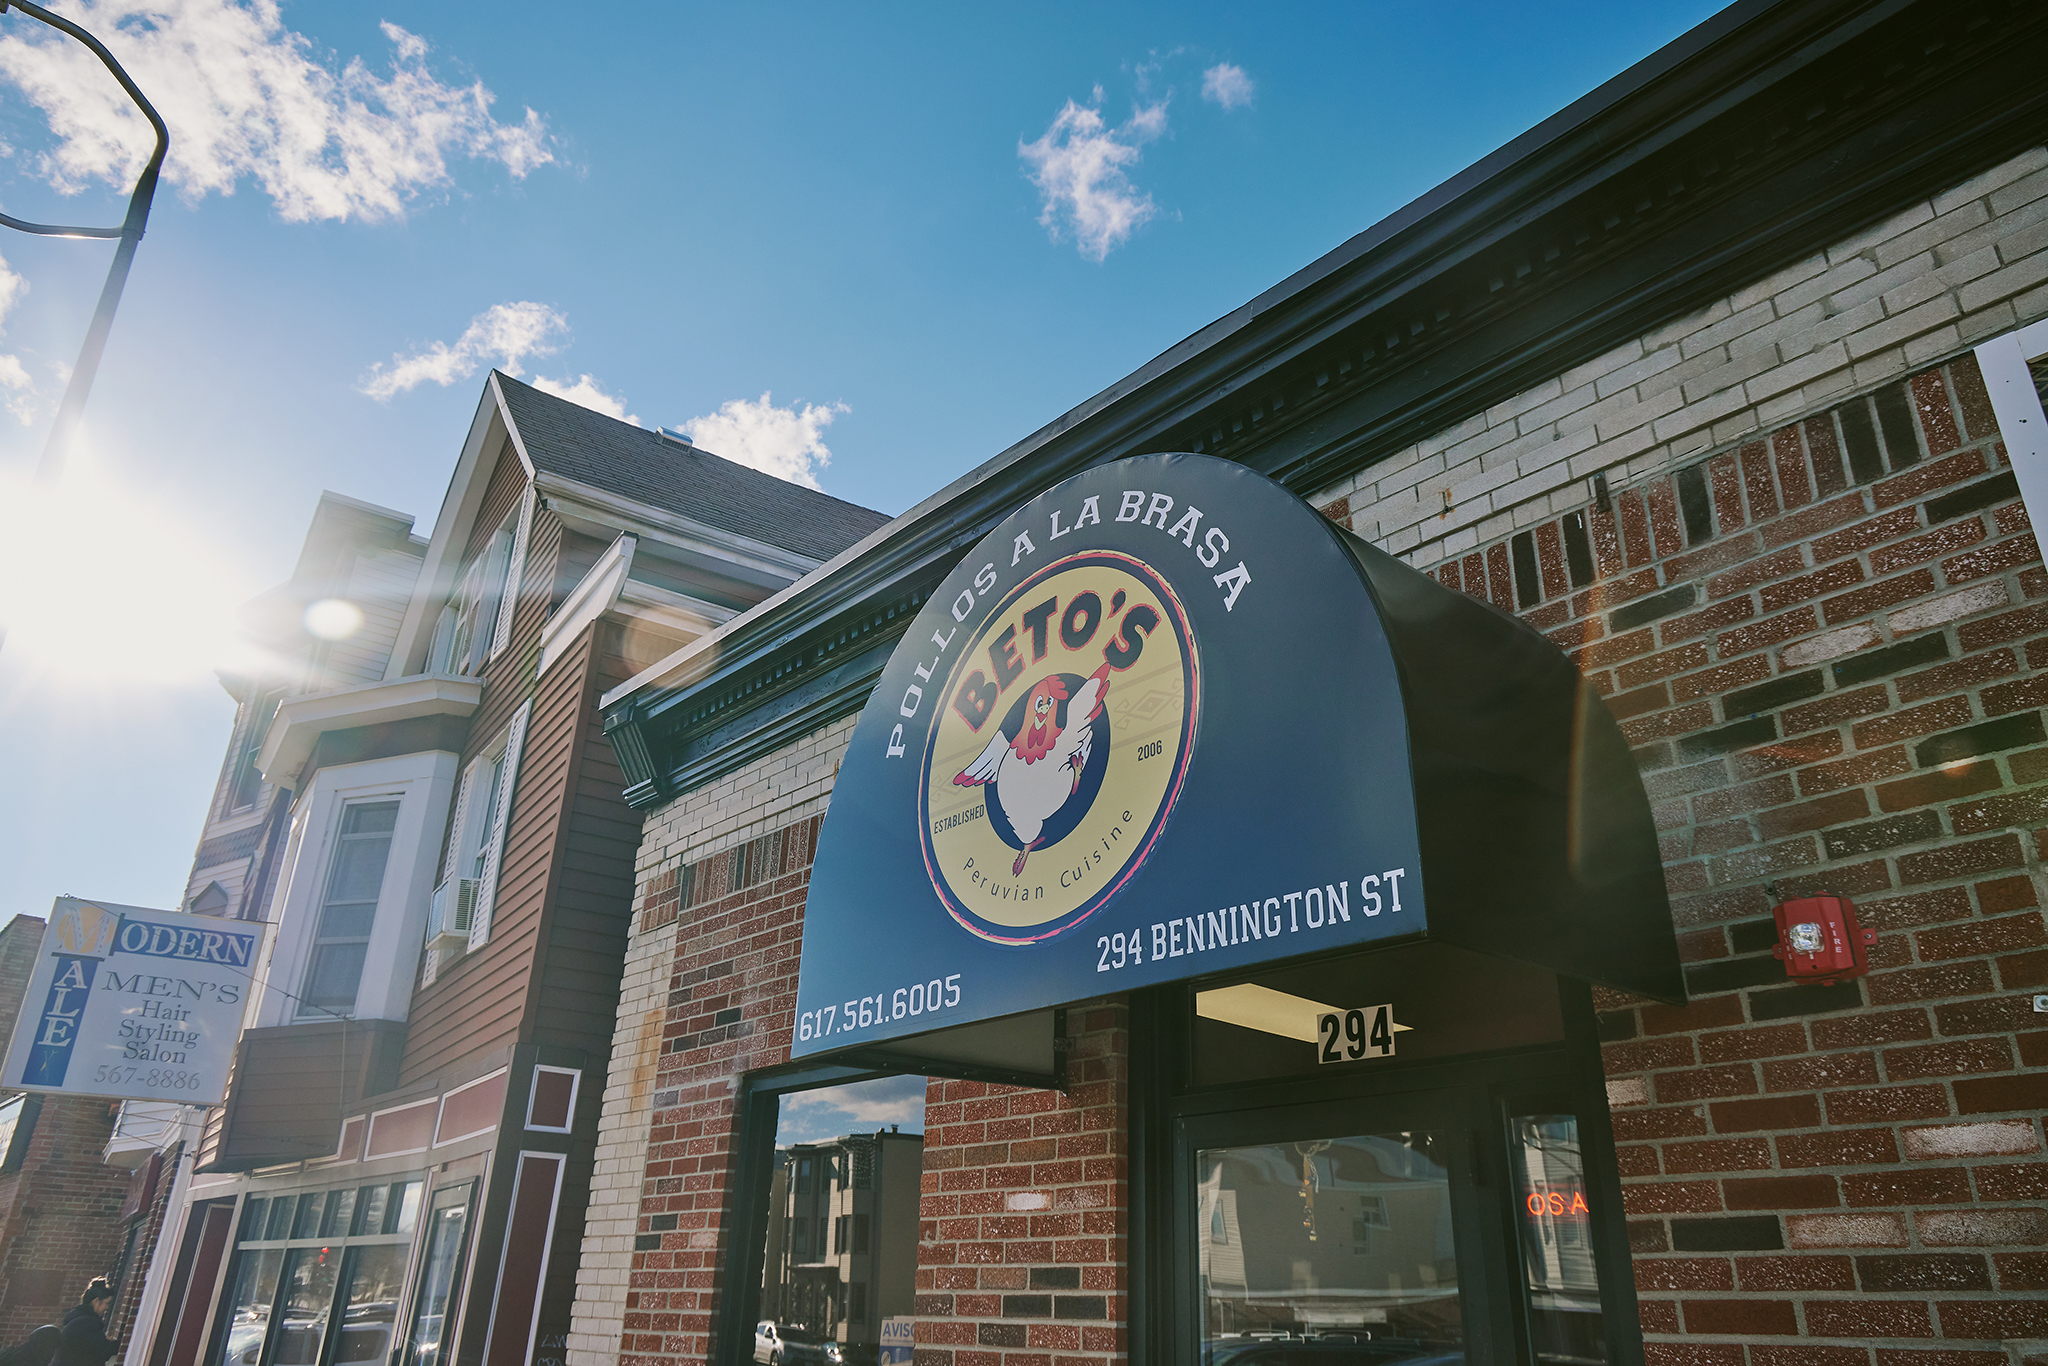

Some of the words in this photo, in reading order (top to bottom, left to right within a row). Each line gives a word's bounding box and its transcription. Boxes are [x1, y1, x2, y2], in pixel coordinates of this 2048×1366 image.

[886, 563, 998, 758] POLLOS
[1011, 529, 1036, 567] A
[1050, 495, 1101, 541] LA
[1115, 490, 1252, 612] BRASA
[951, 588, 1162, 733] BETO'S
[1137, 740, 1163, 761] 2006
[933, 804, 985, 834] ESTABLISHED
[1060, 809, 1133, 888] Cuisine
[963, 857, 1044, 901] Peruvian
[1097, 928, 1142, 972] 294
[1151, 880, 1351, 961] BENNINGTON
[1361, 868, 1405, 917] ST
[1829, 921, 1843, 953] FIRE
[101, 971, 240, 1004] MEN'S
[138, 1000, 191, 1022] Hair
[799, 974, 961, 1042] 617.561.6005
[118, 1019, 200, 1049] Styling
[1321, 1006, 1392, 1062] 294
[122, 1041, 187, 1063] Salon
[94, 1065, 200, 1090] 567-8886
